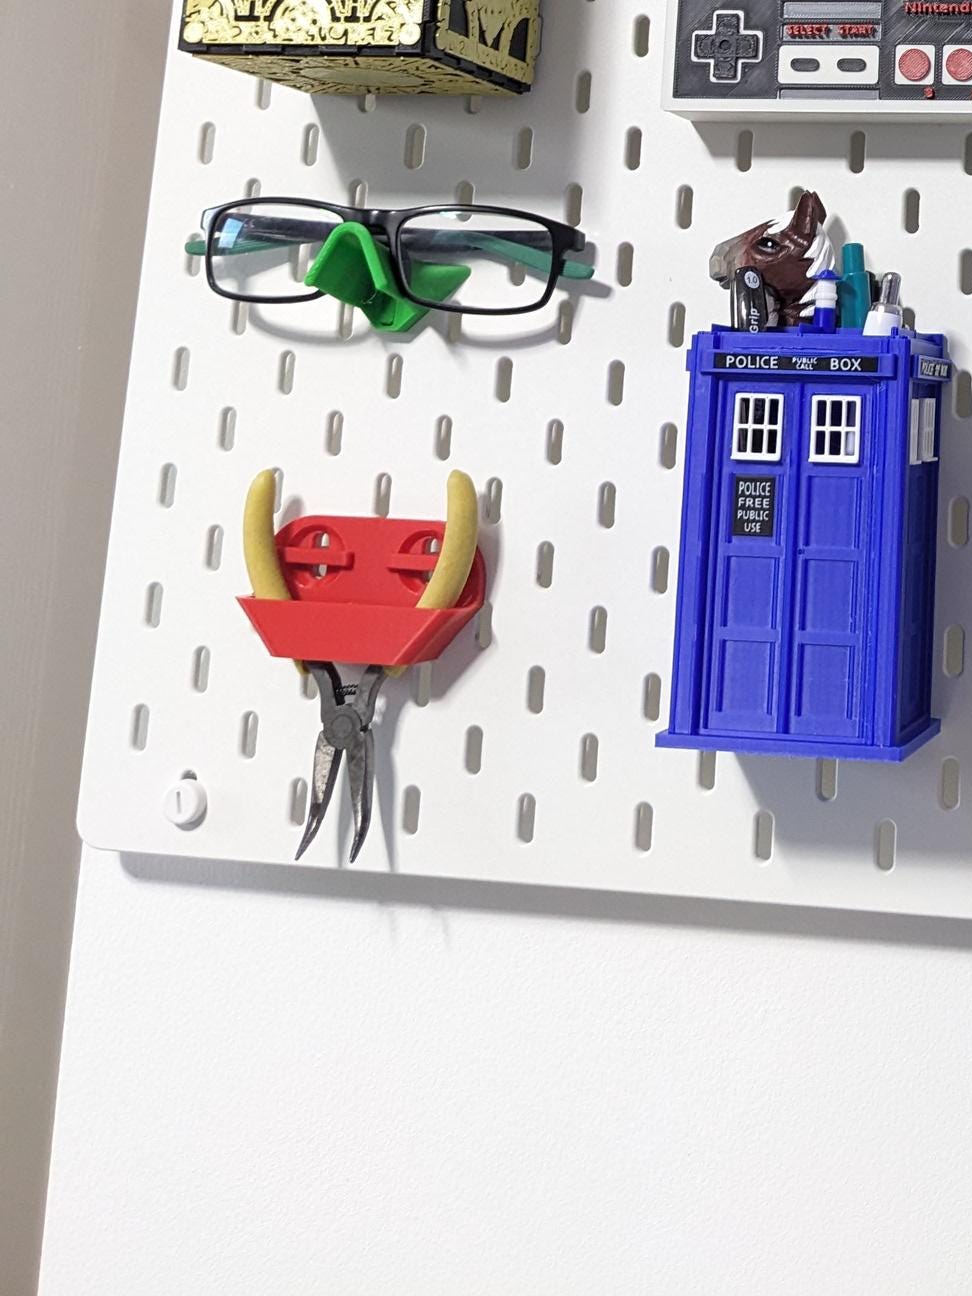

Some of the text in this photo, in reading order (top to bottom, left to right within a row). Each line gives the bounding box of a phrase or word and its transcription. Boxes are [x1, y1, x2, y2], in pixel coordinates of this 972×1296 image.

[786, 24, 874, 36] SELECT START
[749, 308, 759, 333] Grip
[726, 356, 862, 371] POLICE PUBLIC CALL BOX
[738, 481, 771, 496] POLICE
[738, 497, 770, 509] FREE
[737, 509, 769, 521] PUBLIC
[744, 522, 761, 533] USE
